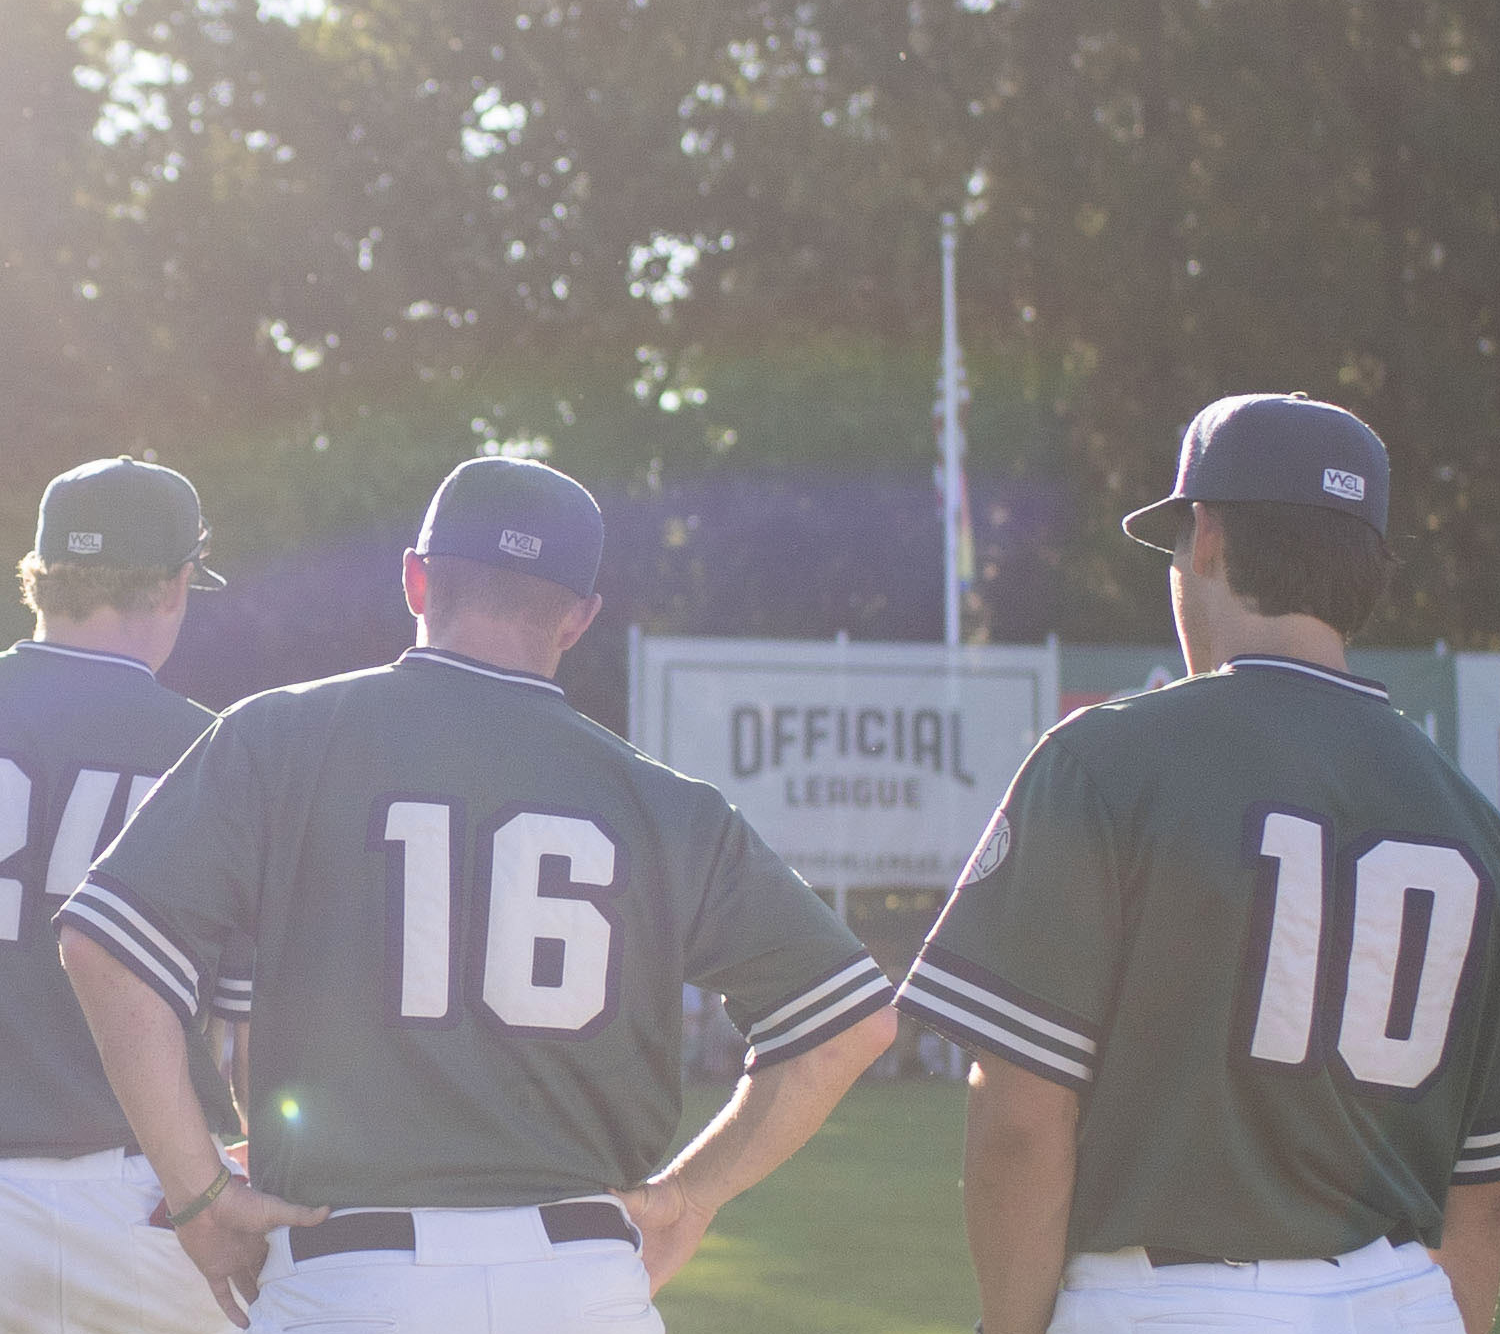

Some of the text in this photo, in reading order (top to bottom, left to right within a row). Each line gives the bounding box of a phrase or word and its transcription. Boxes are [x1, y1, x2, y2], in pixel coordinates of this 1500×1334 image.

[730, 703, 975, 789] OFFICIAL
[784, 774, 923, 809] LEAGUE
[384, 801, 616, 1030] 16
[1250, 812, 1480, 1089] 10
